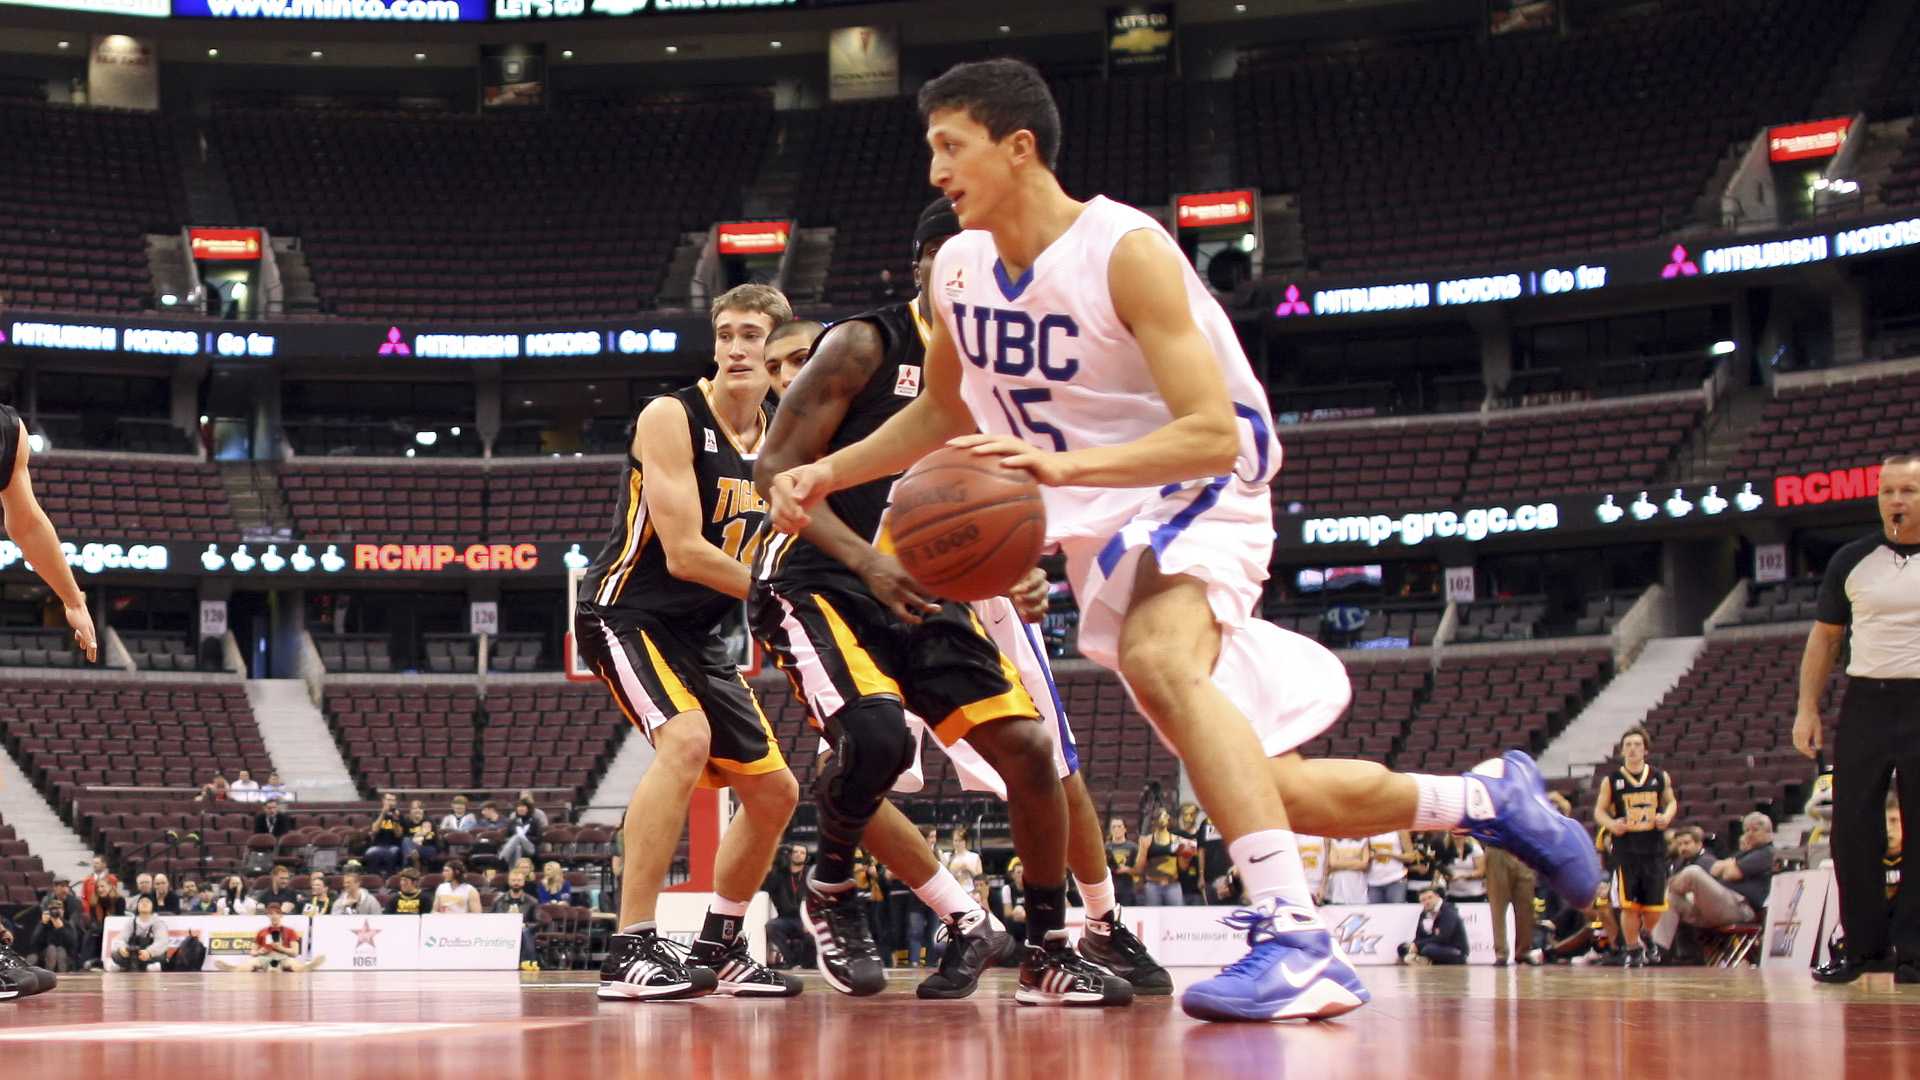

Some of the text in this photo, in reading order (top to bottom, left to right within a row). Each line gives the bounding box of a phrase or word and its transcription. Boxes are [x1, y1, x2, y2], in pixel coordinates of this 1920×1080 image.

[206, 0, 460, 21] www.minto.com
[1703, 217, 1920, 275] MITSUBISHI MOTORS
[1314, 264, 1607, 315] MITSUBISHI MOTORS Go far
[12, 322, 275, 356] MITSUBISHI MOTORS Go far
[525, 331, 601, 357] MOTORS
[619, 329, 648, 353] Go
[953, 302, 1079, 382] UBC
[712, 476, 769, 523] TIGE
[1303, 502, 1558, 546] rcmp-grc.gc.ca
[355, 543, 539, 571] RCMP-GRC
[1758, 553, 1783, 571] 102
[473, 937, 516, 949] Printing
[1176, 932, 1228, 941] MITSUBISHI
